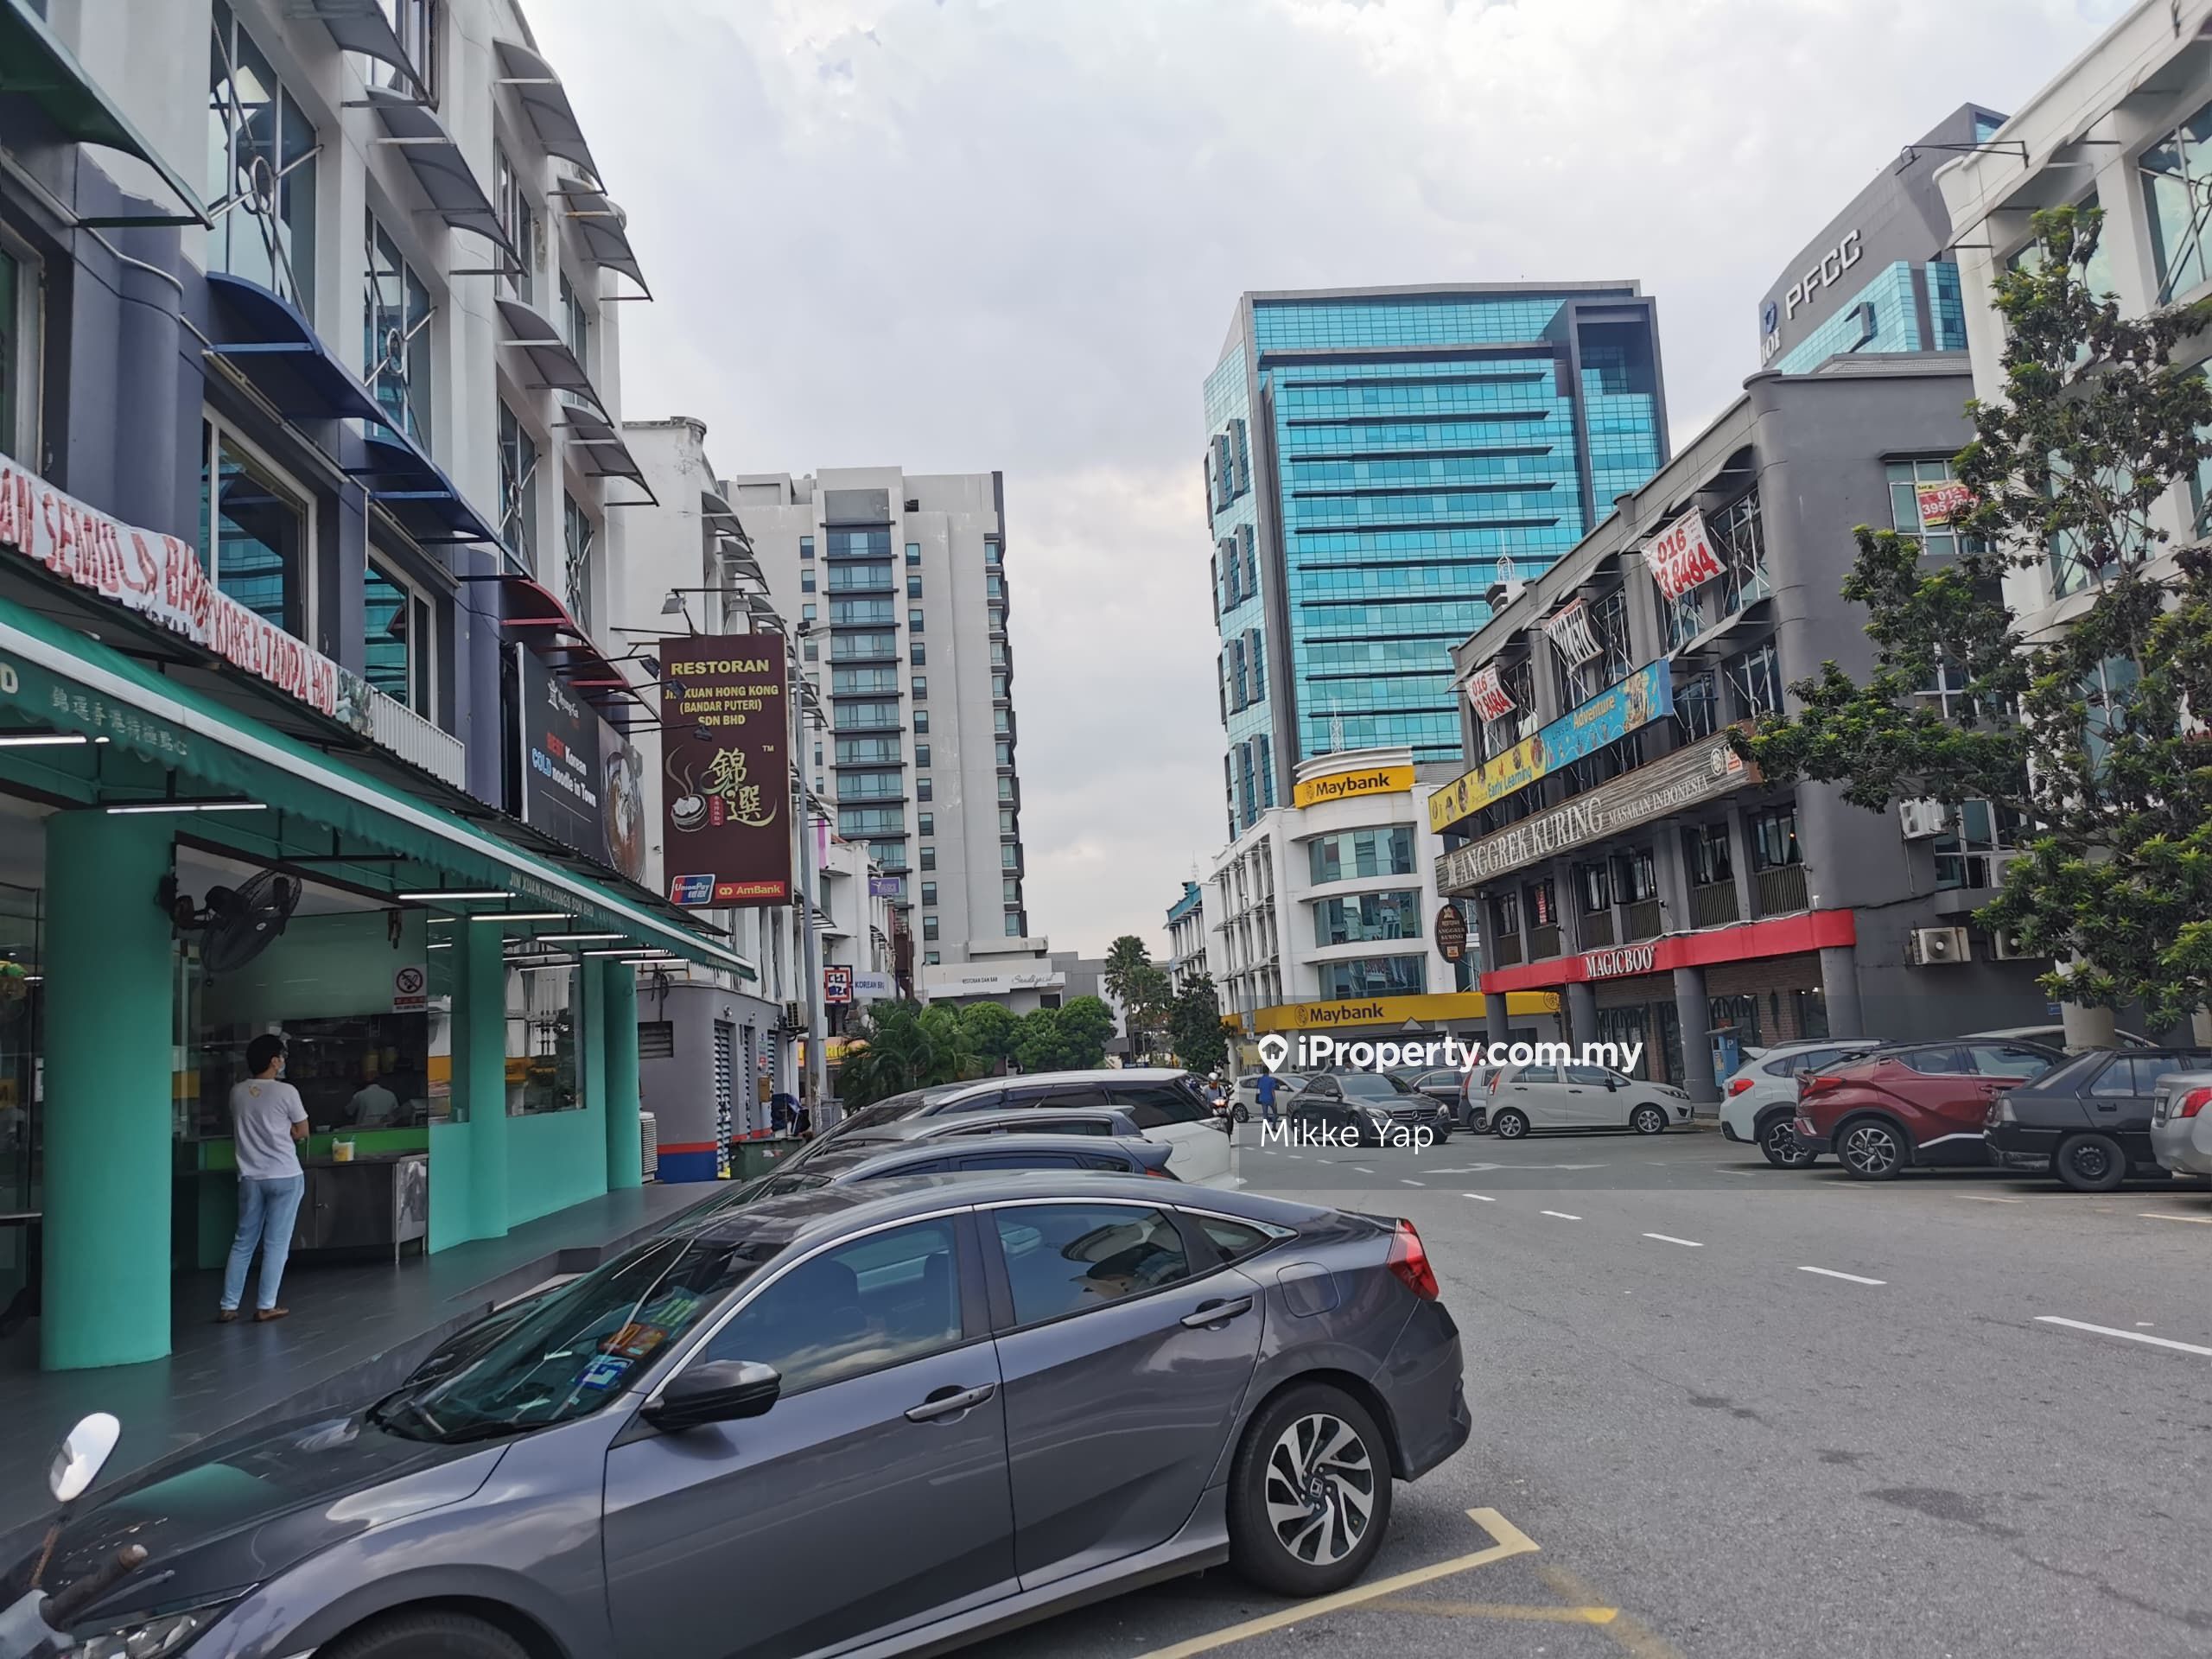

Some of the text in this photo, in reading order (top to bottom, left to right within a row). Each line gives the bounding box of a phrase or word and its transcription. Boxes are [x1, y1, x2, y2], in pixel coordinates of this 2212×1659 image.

[1784, 228, 1863, 320] PFCC
[1922, 502, 1946, 515] 395
[1657, 528, 1687, 564] 016
[1672, 542, 1719, 594] 8484
[671, 659, 769, 675] RESTORAN
[684, 687, 713, 698] XUAN
[715, 686, 747, 697] HONG
[748, 685, 779, 696] KONG
[1471, 675, 1488, 697] 016
[680, 699, 762, 715] (BANDAR PUTERI)
[1482, 688, 1512, 719] 8484
[1573, 695, 1616, 729] Adventure
[698, 715, 746, 726] SDN BHD
[531, 747, 552, 777] COLD
[1315, 772, 1390, 797] Maybank
[1487, 781, 1503, 799] Early
[1503, 766, 1532, 791] Learning
[1460, 774, 1709, 884] ANGGREK KURING MASAKAN INDONESIA
[675, 881, 710, 893] UnionPay
[736, 884, 781, 895] AmBank
[1585, 946, 1652, 978] MAGICBOO
[855, 981, 876, 989] KOREAN
[1309, 1002, 1385, 1025] Maybank
[1726, 1039, 1734, 1049] P
